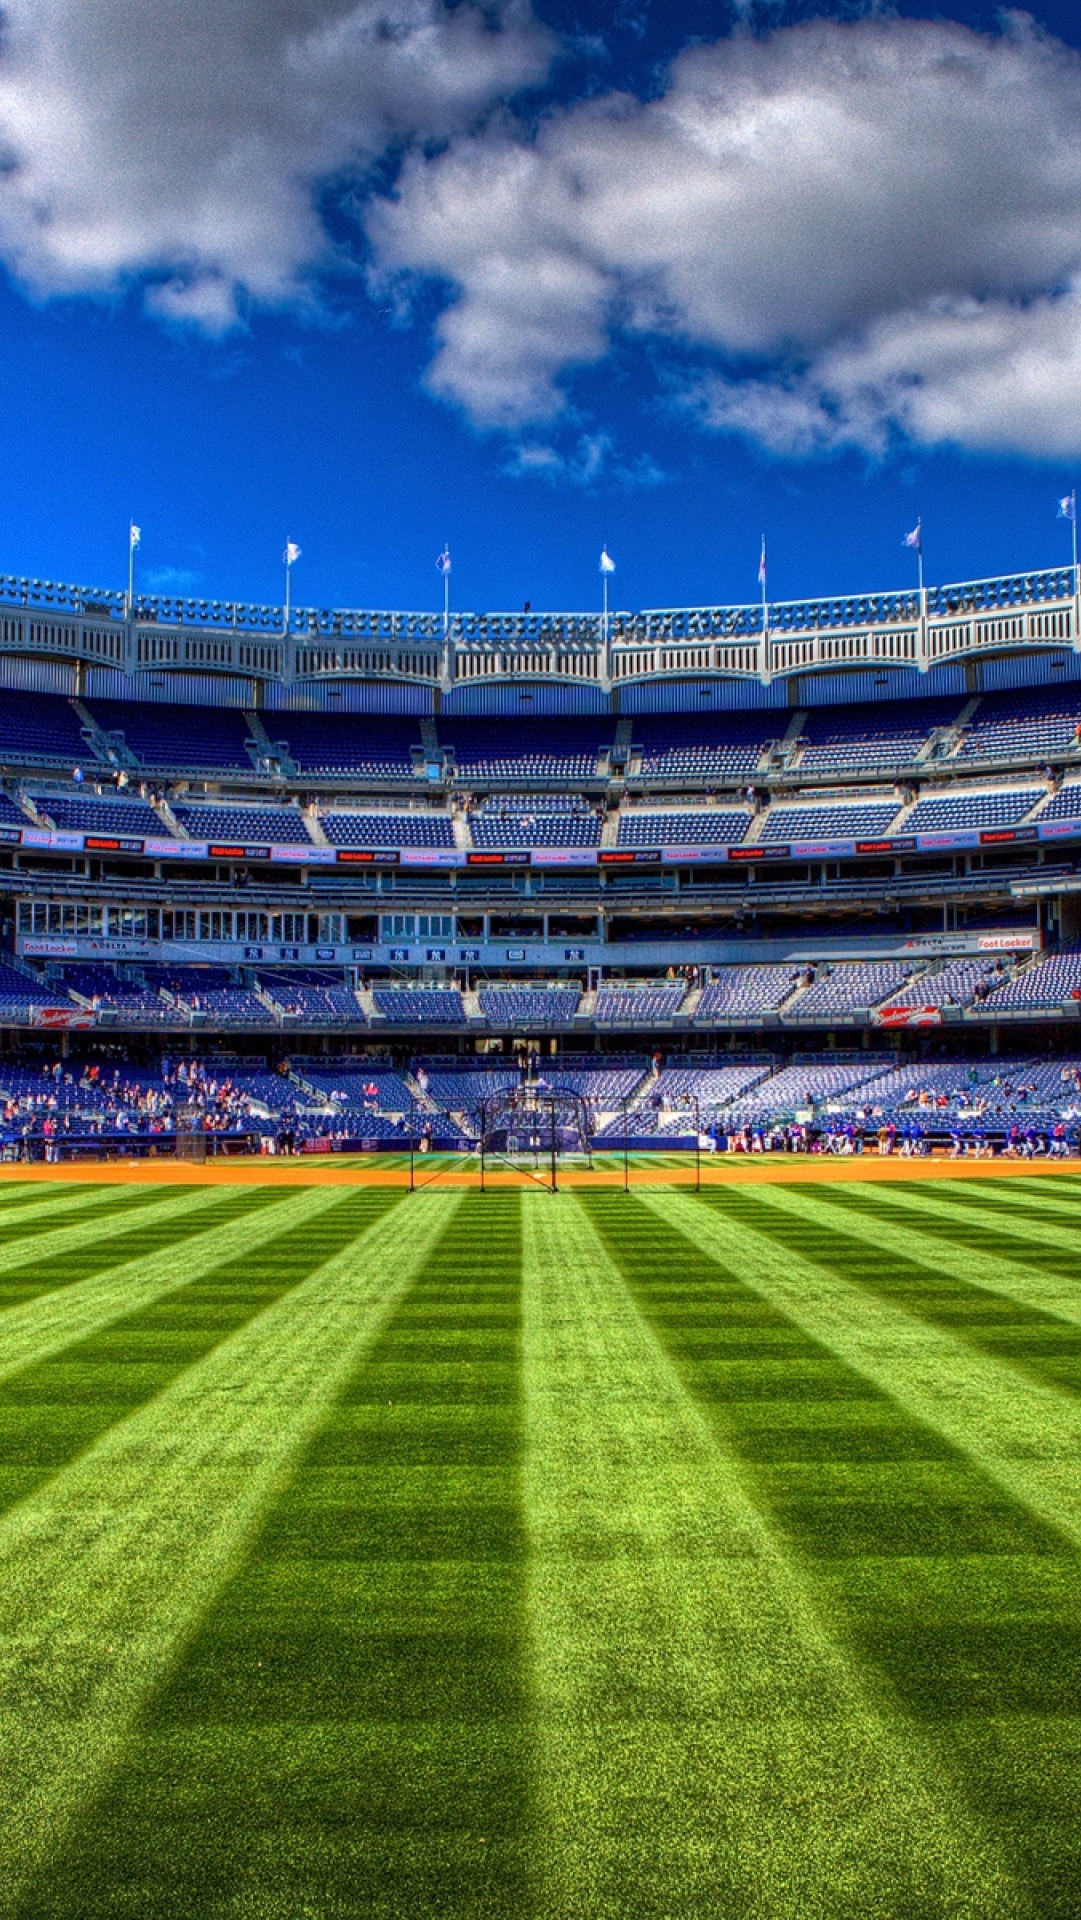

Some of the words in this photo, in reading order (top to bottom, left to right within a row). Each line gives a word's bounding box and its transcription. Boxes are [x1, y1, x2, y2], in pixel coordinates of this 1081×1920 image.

[979, 938, 998, 948] Foot
[1000, 937, 1032, 947] Locker
[24, 943, 44, 952] Foot
[46, 943, 76, 954] Locker
